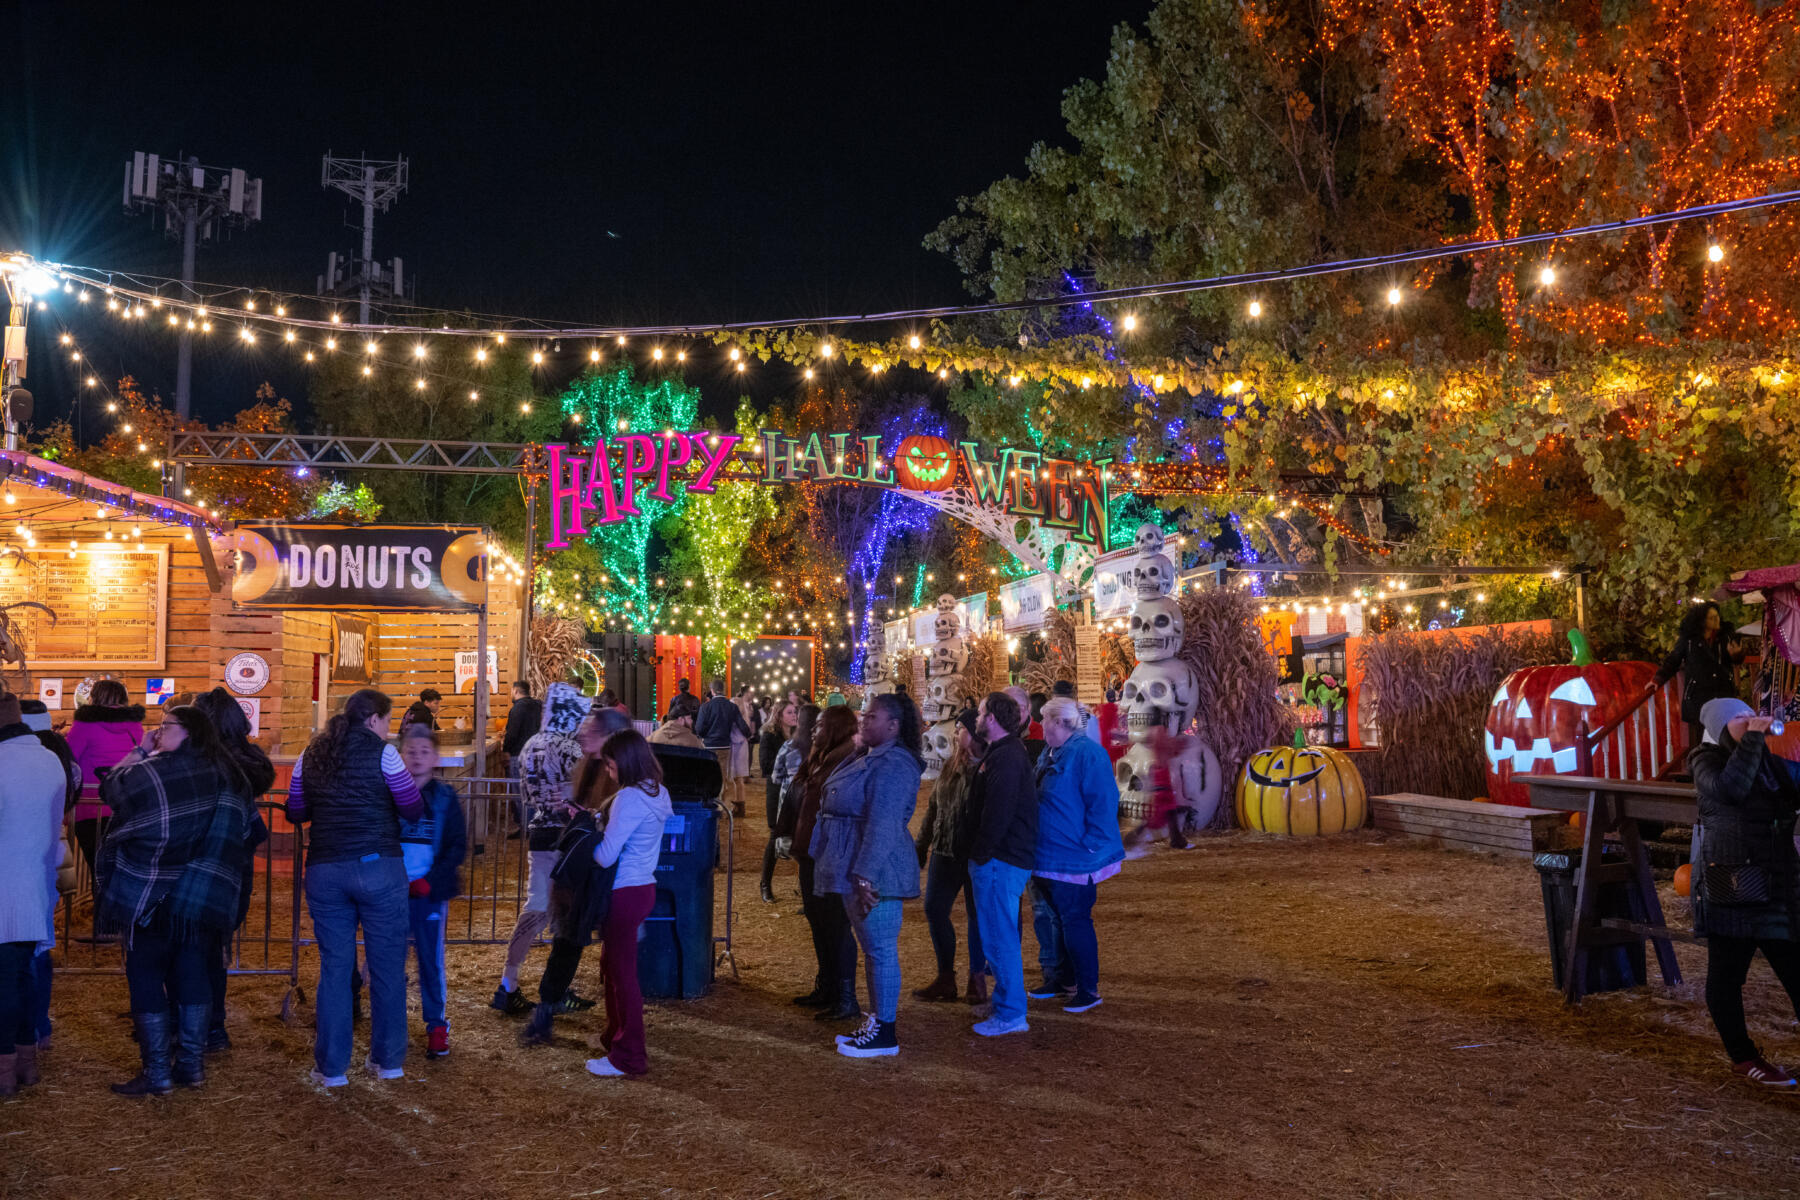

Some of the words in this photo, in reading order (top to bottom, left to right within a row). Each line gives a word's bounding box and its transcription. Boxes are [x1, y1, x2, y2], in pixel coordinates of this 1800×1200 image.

[545, 431, 742, 548] HAPPY
[289, 544, 432, 589] DONUTS
[340, 630, 364, 667] DONUTS
[461, 654, 491, 665] DONS
[459, 665, 474, 675] FOR
